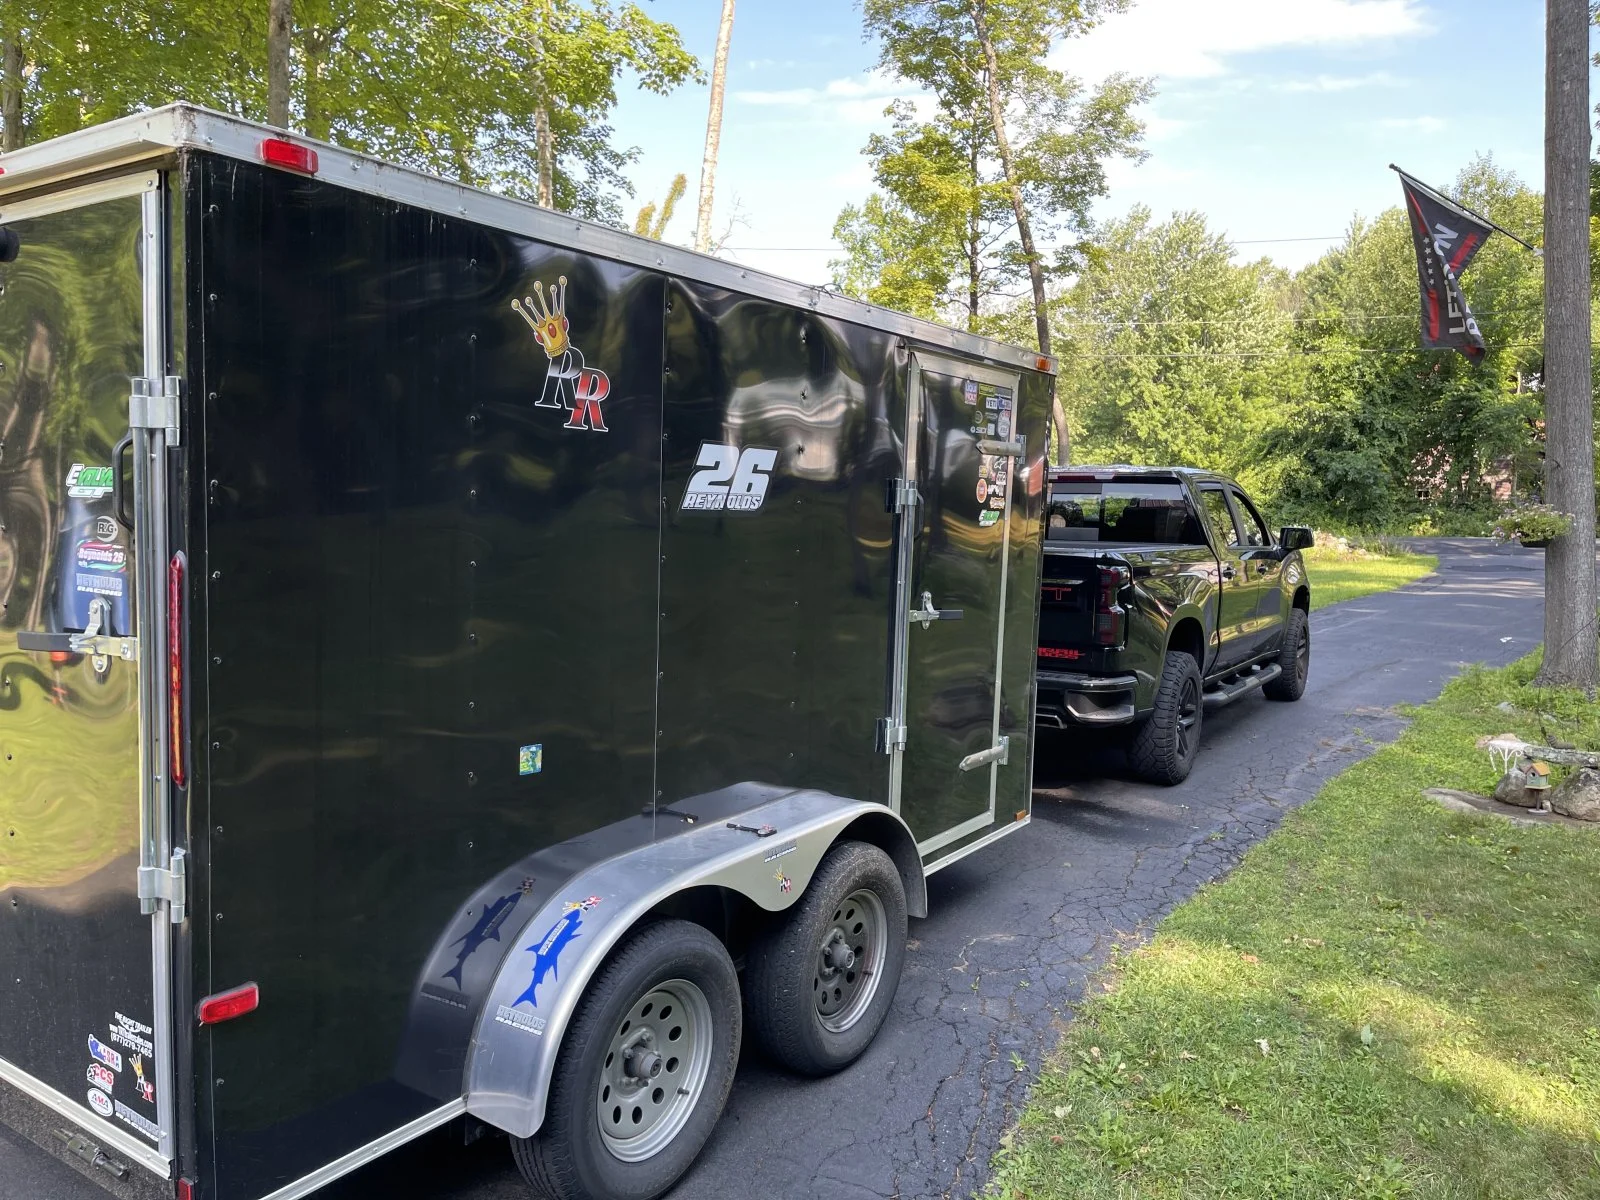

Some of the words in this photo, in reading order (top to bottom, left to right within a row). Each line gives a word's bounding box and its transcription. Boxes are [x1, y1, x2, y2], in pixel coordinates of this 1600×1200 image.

[987, 399, 997, 408] YETI
[688, 443, 778, 494] 26
[682, 491, 763, 511] REYNOLDS
[78, 548, 112, 563] Reynolds
[112, 552, 124, 563] 26
[114, 1011, 123, 1021] THE
[134, 1021, 152, 1035] TRAILER
[497, 1005, 546, 1028] REYNOLDS
[495, 1017, 543, 1036] RACING
[91, 1093, 110, 1109] AMA
